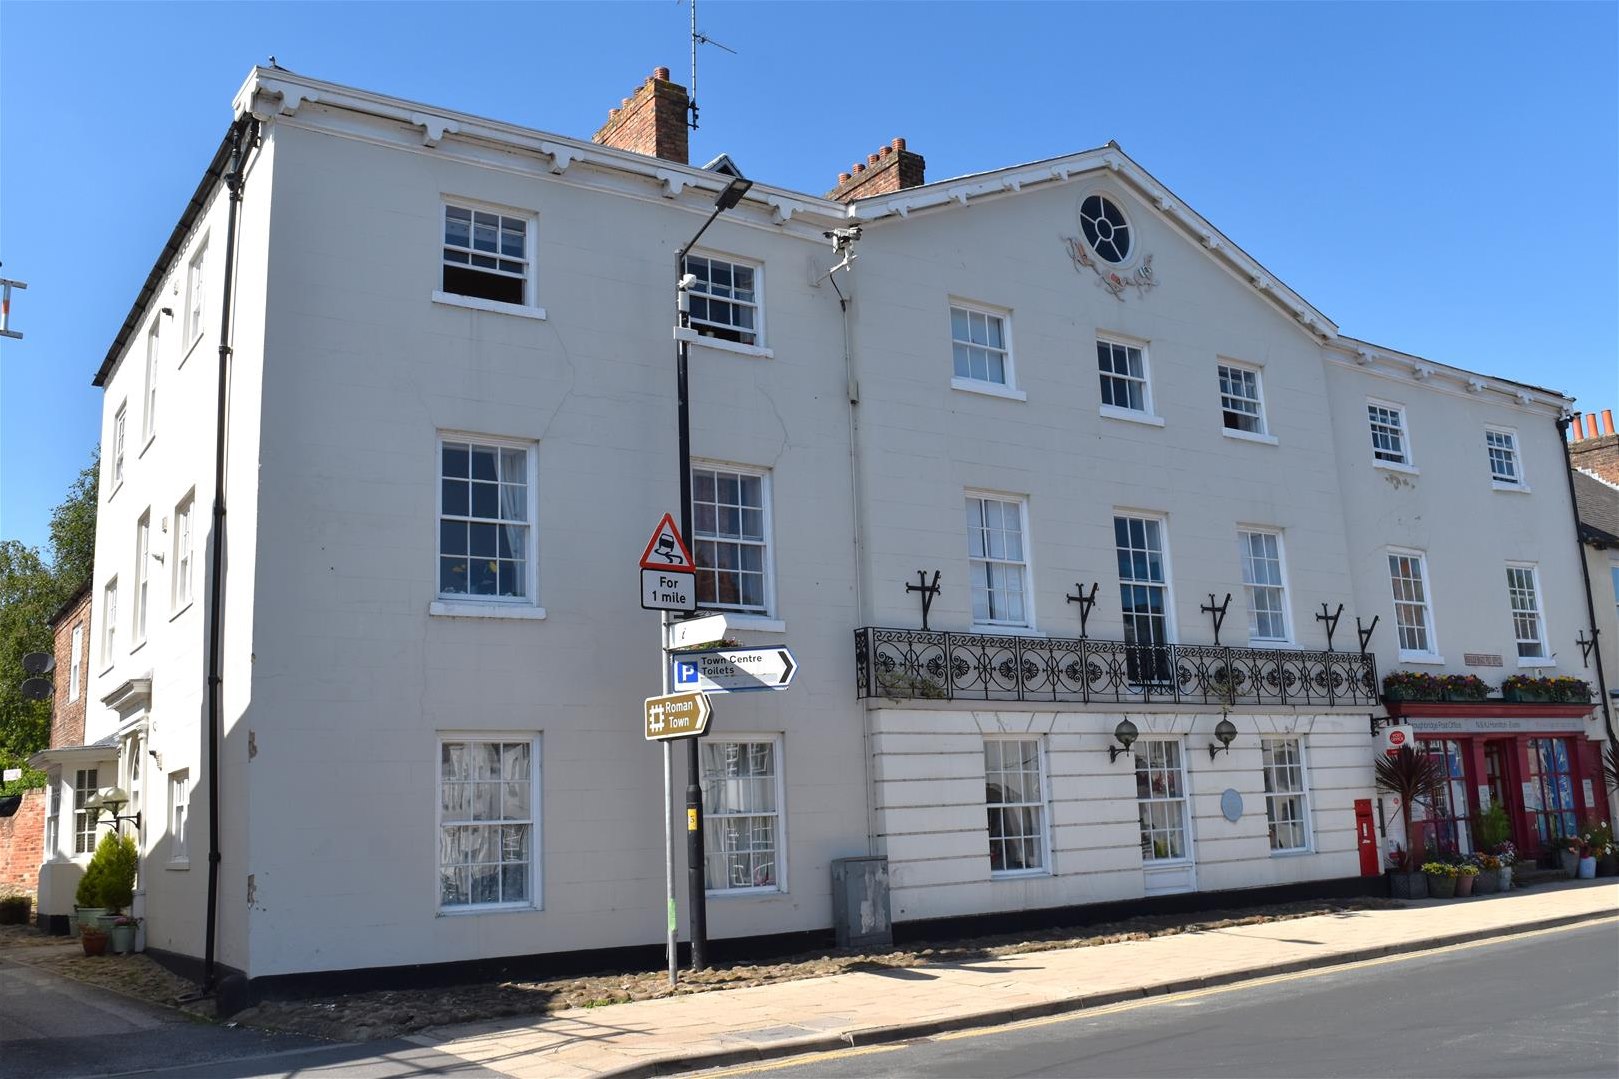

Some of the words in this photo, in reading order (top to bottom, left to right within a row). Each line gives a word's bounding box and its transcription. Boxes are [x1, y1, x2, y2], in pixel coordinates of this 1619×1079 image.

[660, 576, 678, 588] For
[652, 591, 657, 601] 1
[662, 592, 686, 603] mile
[701, 656, 726, 665] Town
[729, 655, 762, 664] Centre
[682, 665, 695, 681] P
[701, 666, 735, 675] Toilets
[665, 701, 693, 713] Roman
[668, 716, 689, 728] Town
